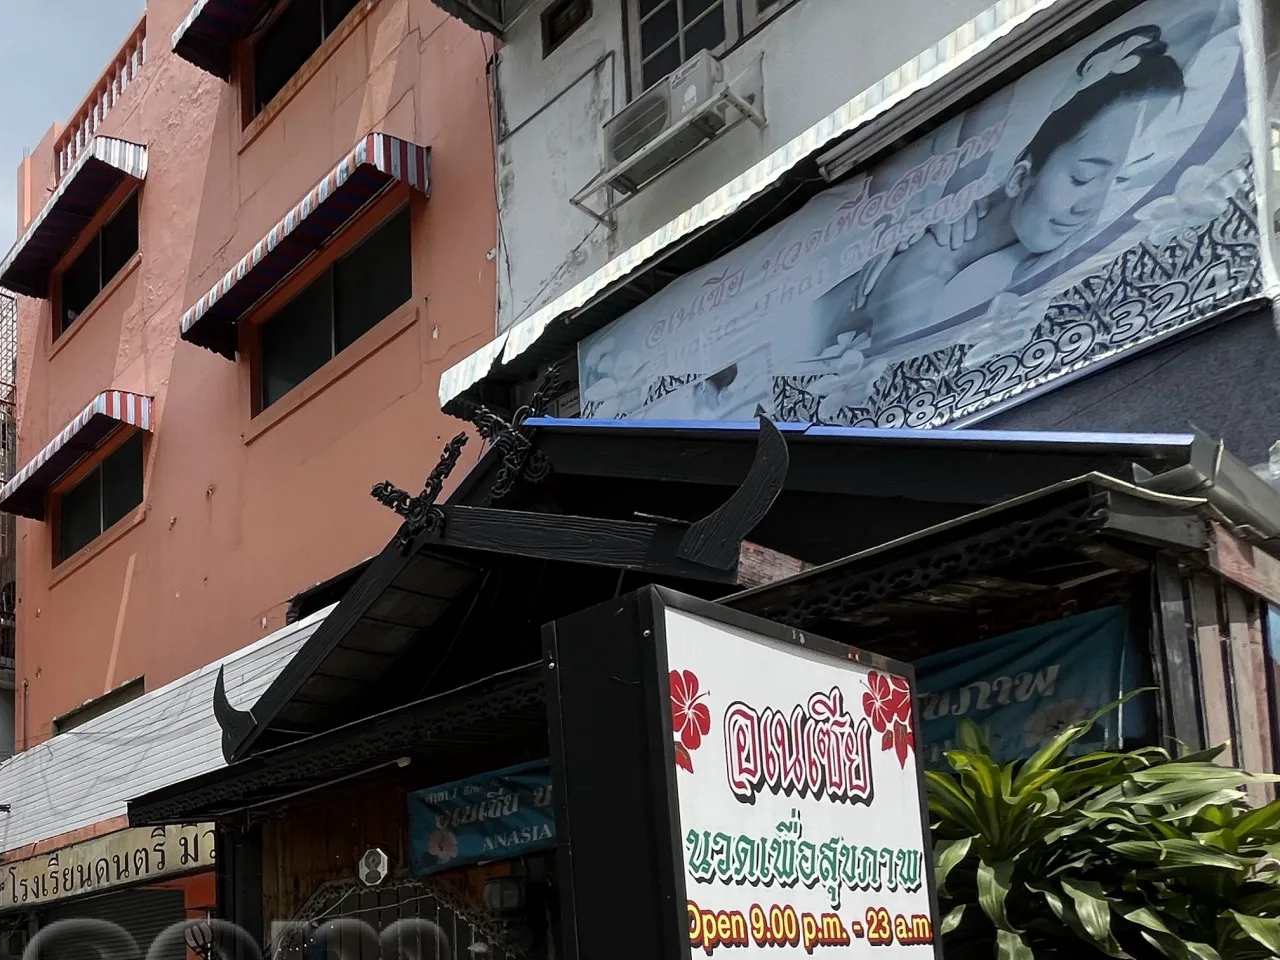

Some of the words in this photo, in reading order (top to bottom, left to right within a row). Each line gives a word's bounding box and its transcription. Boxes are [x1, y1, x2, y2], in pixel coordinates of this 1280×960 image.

[853, 321, 1097, 428] 98-2299
[1109, 259, 1237, 344] 324
[8, 825, 167, 903] โรงเรียนดนตรี
[482, 823, 553, 851] ANASIA
[686, 809, 921, 910] นวดเพื่อสุขภาพ
[687, 901, 747, 954] Open
[750, 902, 800, 947] 9.00
[803, 911, 850, 953] p.m.
[866, 906, 892, 946] 23
